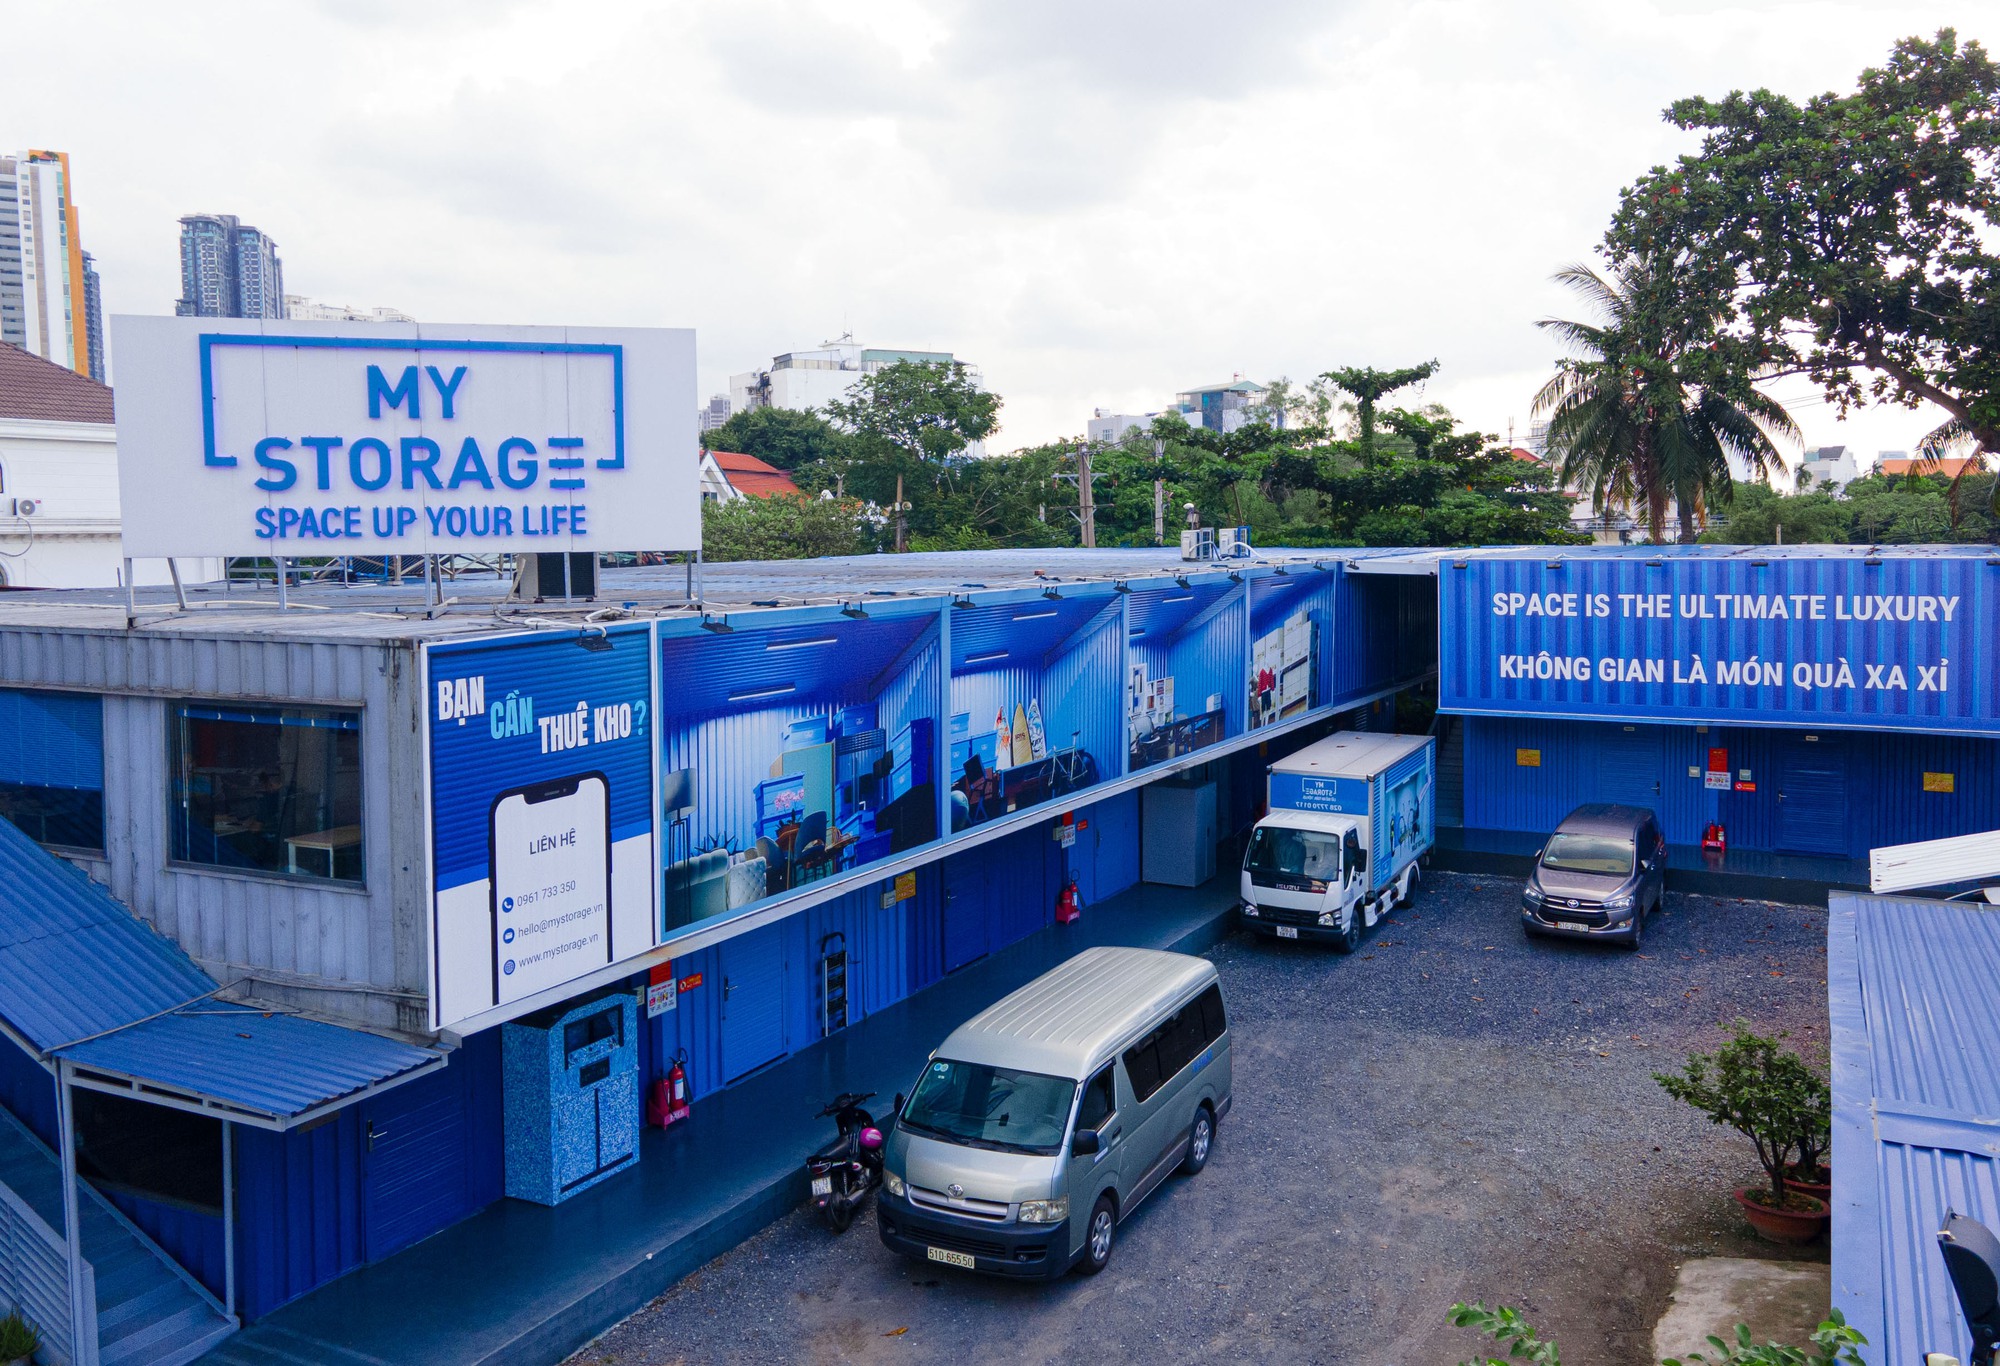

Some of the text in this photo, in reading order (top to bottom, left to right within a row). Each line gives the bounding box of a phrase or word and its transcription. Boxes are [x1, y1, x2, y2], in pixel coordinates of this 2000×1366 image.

[366, 364, 468, 419] MY
[254, 435, 586, 491] STORAGE
[255, 504, 587, 538] SPACE UP YOUR LIFE
[1492, 592, 1960, 621] SPACE IS THE ULTIMATE LUXURY
[1500, 650, 1949, 692] KHÔNG GIAN LÀ MÓN QUÀ XA XỈ
[438, 676, 485, 726] BẠN
[490, 689, 534, 740] CẦN
[538, 701, 589, 754] THUÊ
[529, 828, 576, 855] LIÊN HỆ
[516, 880, 576, 907] 0961 733 350
[518, 903, 603, 938] hello@mystorage.vn
[518, 932, 599, 968] www.mystorage.vn
